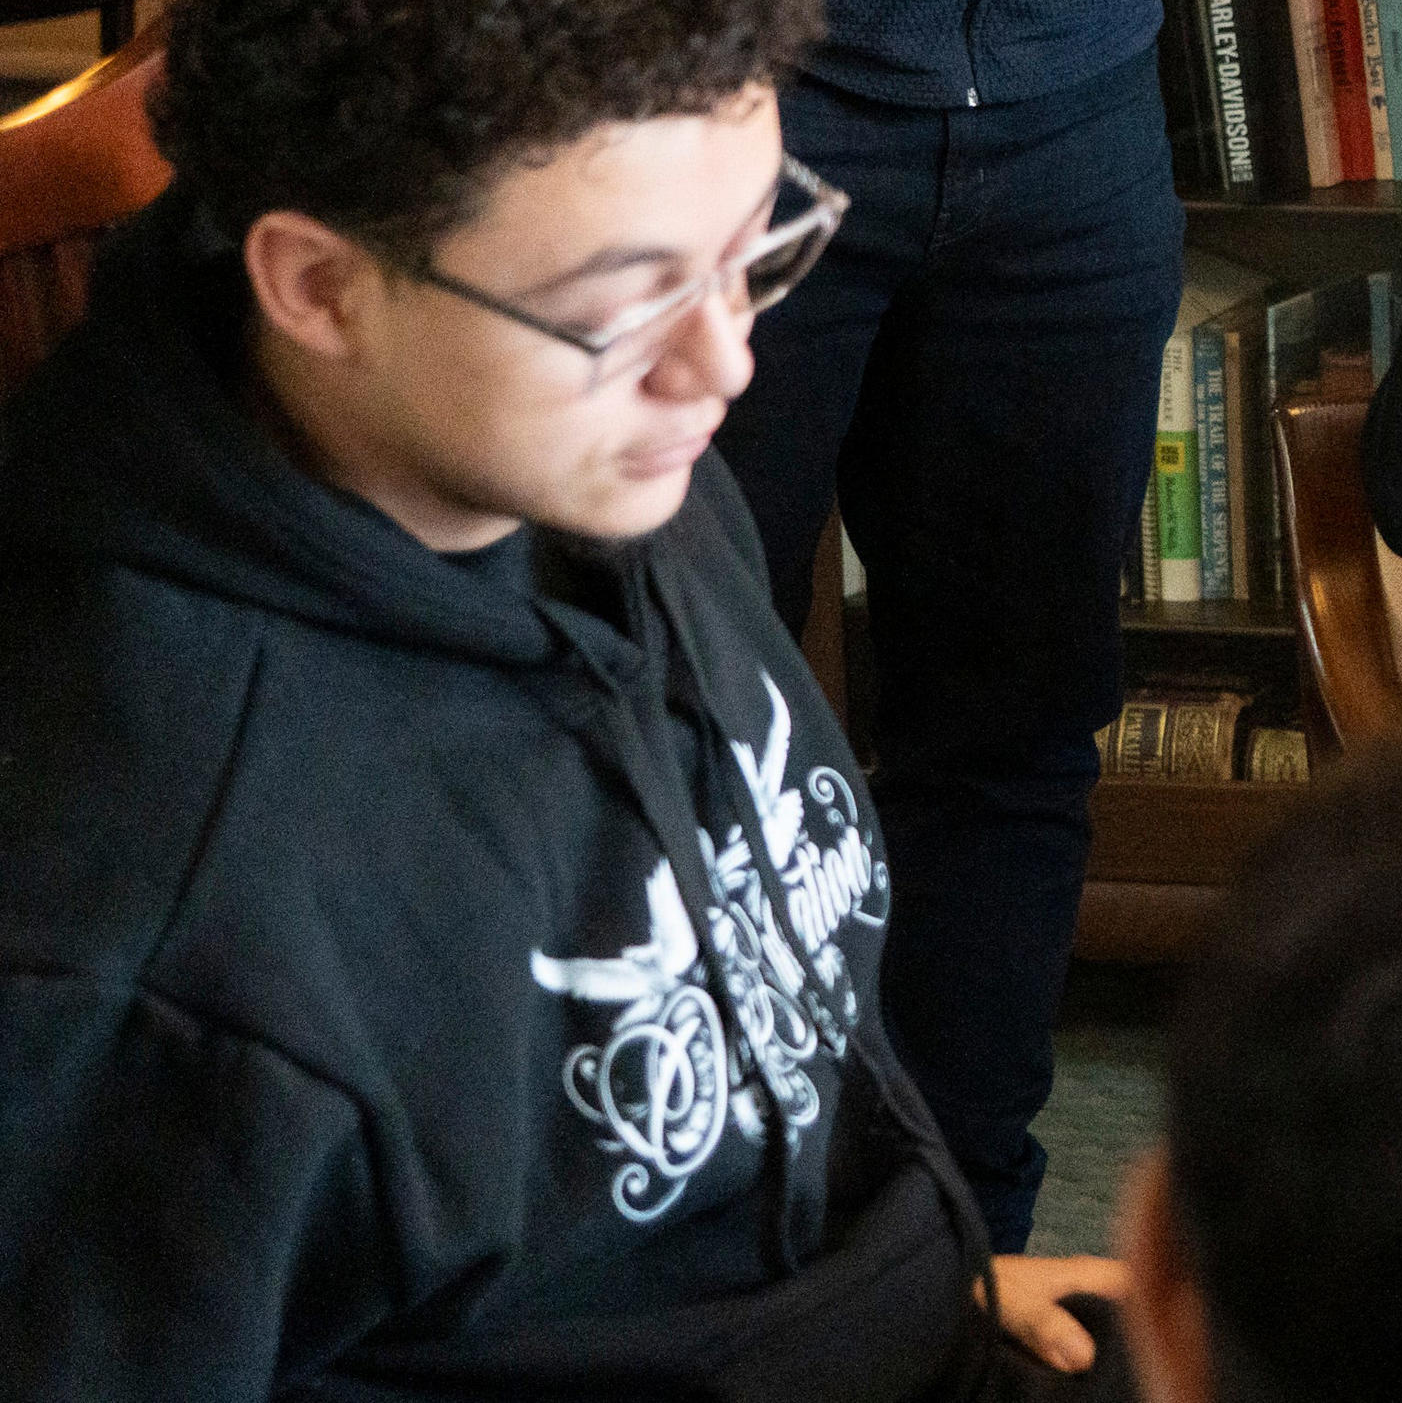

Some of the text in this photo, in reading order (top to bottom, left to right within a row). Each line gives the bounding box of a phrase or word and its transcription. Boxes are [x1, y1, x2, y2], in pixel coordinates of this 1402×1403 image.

[1207, 367, 1225, 396] THE
[1207, 403, 1226, 447] TRAIL
[1209, 454, 1227, 472] OF
[1210, 479, 1228, 506] THE
[1211, 510, 1230, 578] SERPENT
